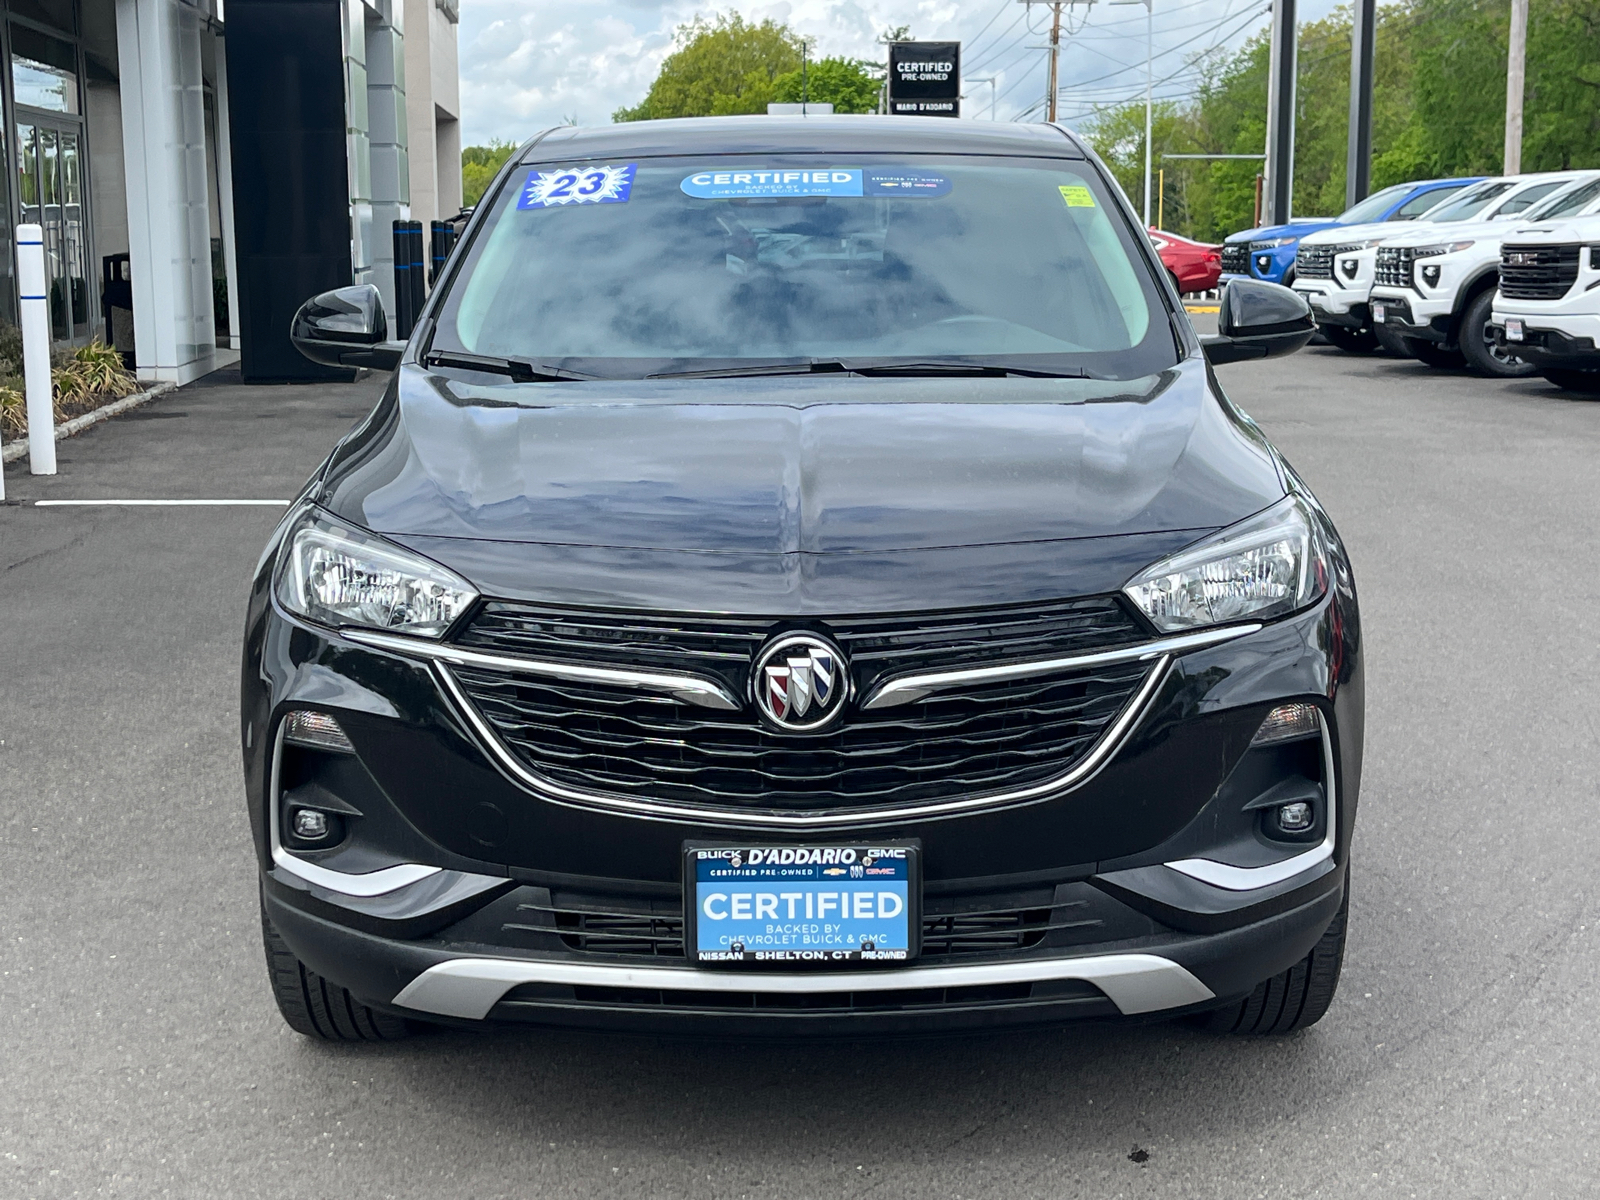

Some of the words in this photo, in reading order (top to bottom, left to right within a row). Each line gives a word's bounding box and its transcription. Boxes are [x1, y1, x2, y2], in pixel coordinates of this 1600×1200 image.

[897, 62, 953, 72] CERTIFIED
[691, 172, 853, 185] CERTIFIED
[546, 172, 606, 198] 23
[697, 850, 742, 859] BUICK
[748, 848, 857, 865] D'ADDARIO
[867, 849, 906, 858] GMC
[703, 892, 903, 920] CERTIFIED
[766, 924, 819, 934] BACKED
[824, 924, 841, 933] BY
[719, 935, 797, 945] CHEVROLET
[803, 934, 842, 944] BUICK
[846, 934, 855, 943] &
[859, 934, 887, 943] GMC
[699, 951, 743, 960] NISSAN
[755, 951, 828, 960] SHELTON,
[831, 951, 852, 959] CT
[861, 951, 907, 959] PRE-OWNED
